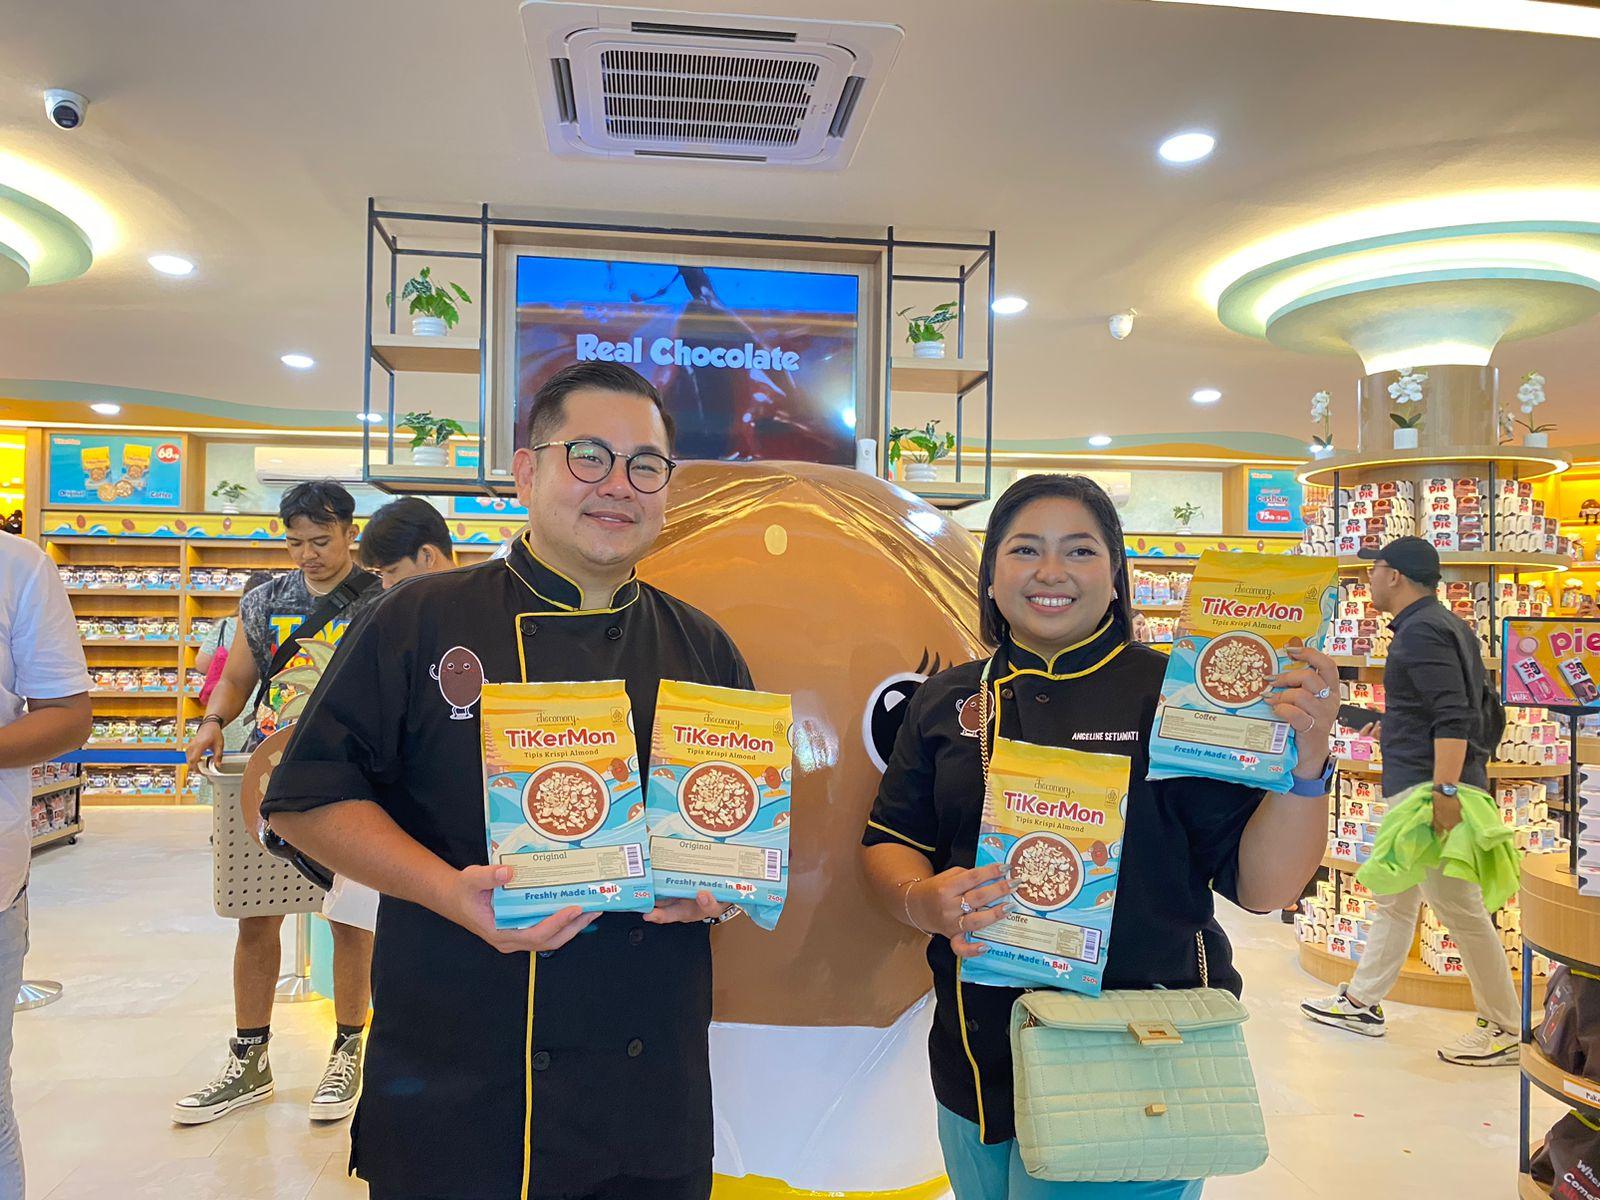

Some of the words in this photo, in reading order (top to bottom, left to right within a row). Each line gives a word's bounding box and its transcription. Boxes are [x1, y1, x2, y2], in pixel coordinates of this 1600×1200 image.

[576, 333, 643, 363] Real
[650, 337, 801, 371] Chocolate
[1202, 597, 1303, 621] TiKerMon
[1229, 620, 1251, 629] Krispi
[1252, 622, 1281, 630] Almond
[1550, 628, 1600, 657] pie
[1194, 712, 1217, 722] Coffee
[505, 728, 616, 748] TiKerMon
[672, 725, 775, 753] TiKerMon
[524, 751, 543, 759] Tipis
[544, 750, 568, 758] Krispi
[570, 749, 599, 757] Almond
[705, 750, 728, 758] Krispi
[729, 752, 756, 760] Almond
[1174, 745, 1202, 757] Freshly
[1204, 750, 1227, 759] Made
[1239, 755, 1256, 763] Bali
[1003, 791, 1105, 825] TiKerMon
[1016, 816, 1033, 824] Tipis
[1034, 819, 1056, 828] Krispi
[1057, 822, 1084, 833] Almond
[680, 841, 712, 851] Original
[532, 851, 567, 862] Original
[665, 877, 696, 887] Freshly
[698, 880, 723, 888] Made
[525, 890, 557, 900] Freshly
[560, 889, 586, 897] Made
[599, 884, 617, 894] Bali
[1017, 952, 1040, 964] Made
[1042, 959, 1051, 967] in
[1052, 961, 1069, 971] Bali
[1564, 1173, 1600, 1200] Come
